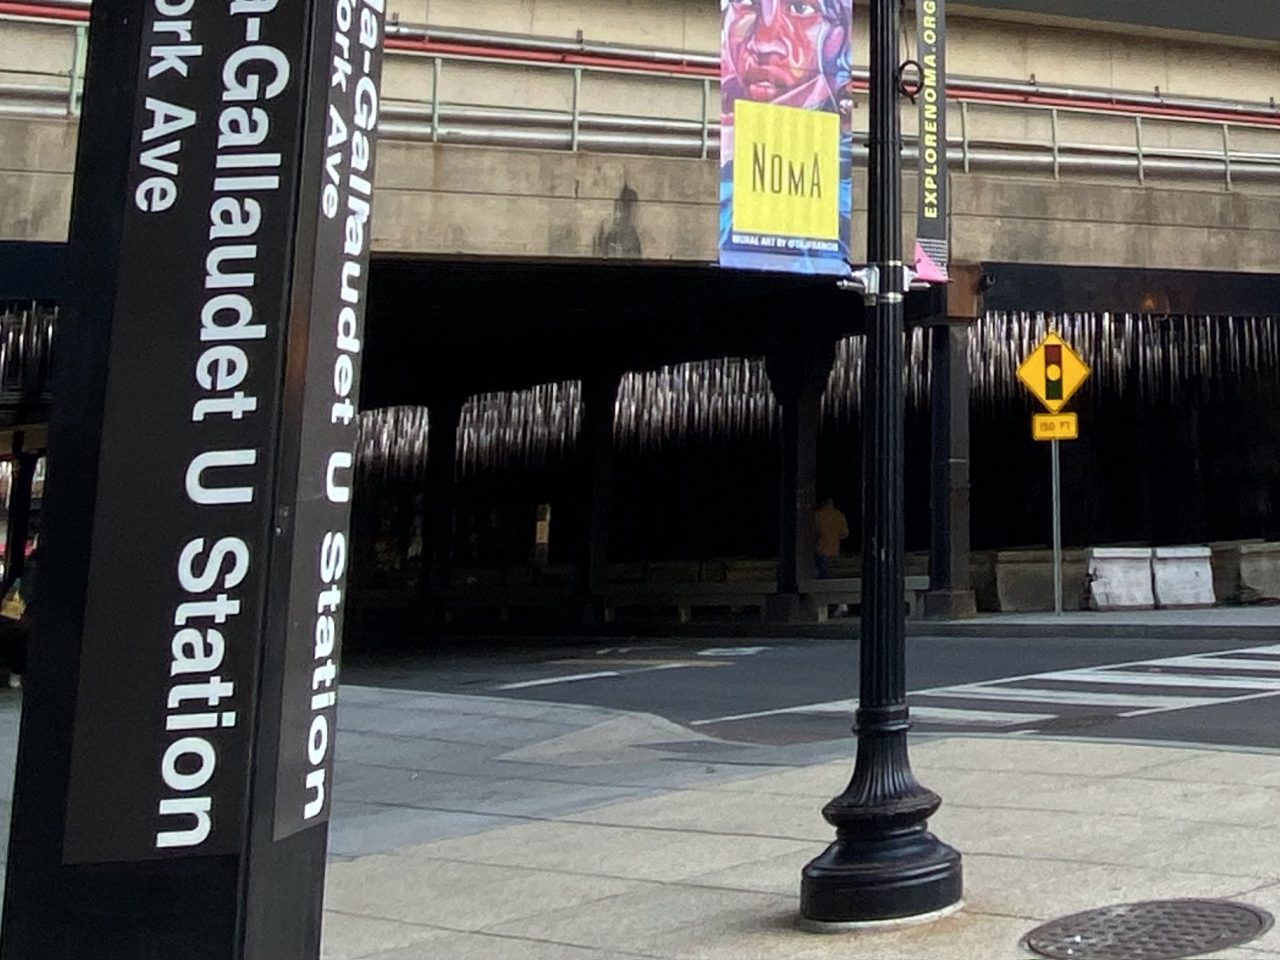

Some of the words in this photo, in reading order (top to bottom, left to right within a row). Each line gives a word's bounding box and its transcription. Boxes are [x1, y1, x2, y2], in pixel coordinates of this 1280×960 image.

[134, 97, 197, 213] Ave
[321, 103, 348, 220] Ave
[923, 0, 937, 219] EXPLORENOMA.ORG
[184, 449, 257, 505] U
[324, 451, 352, 504] U
[155, 536, 250, 848] Station
[303, 531, 346, 820] Station
